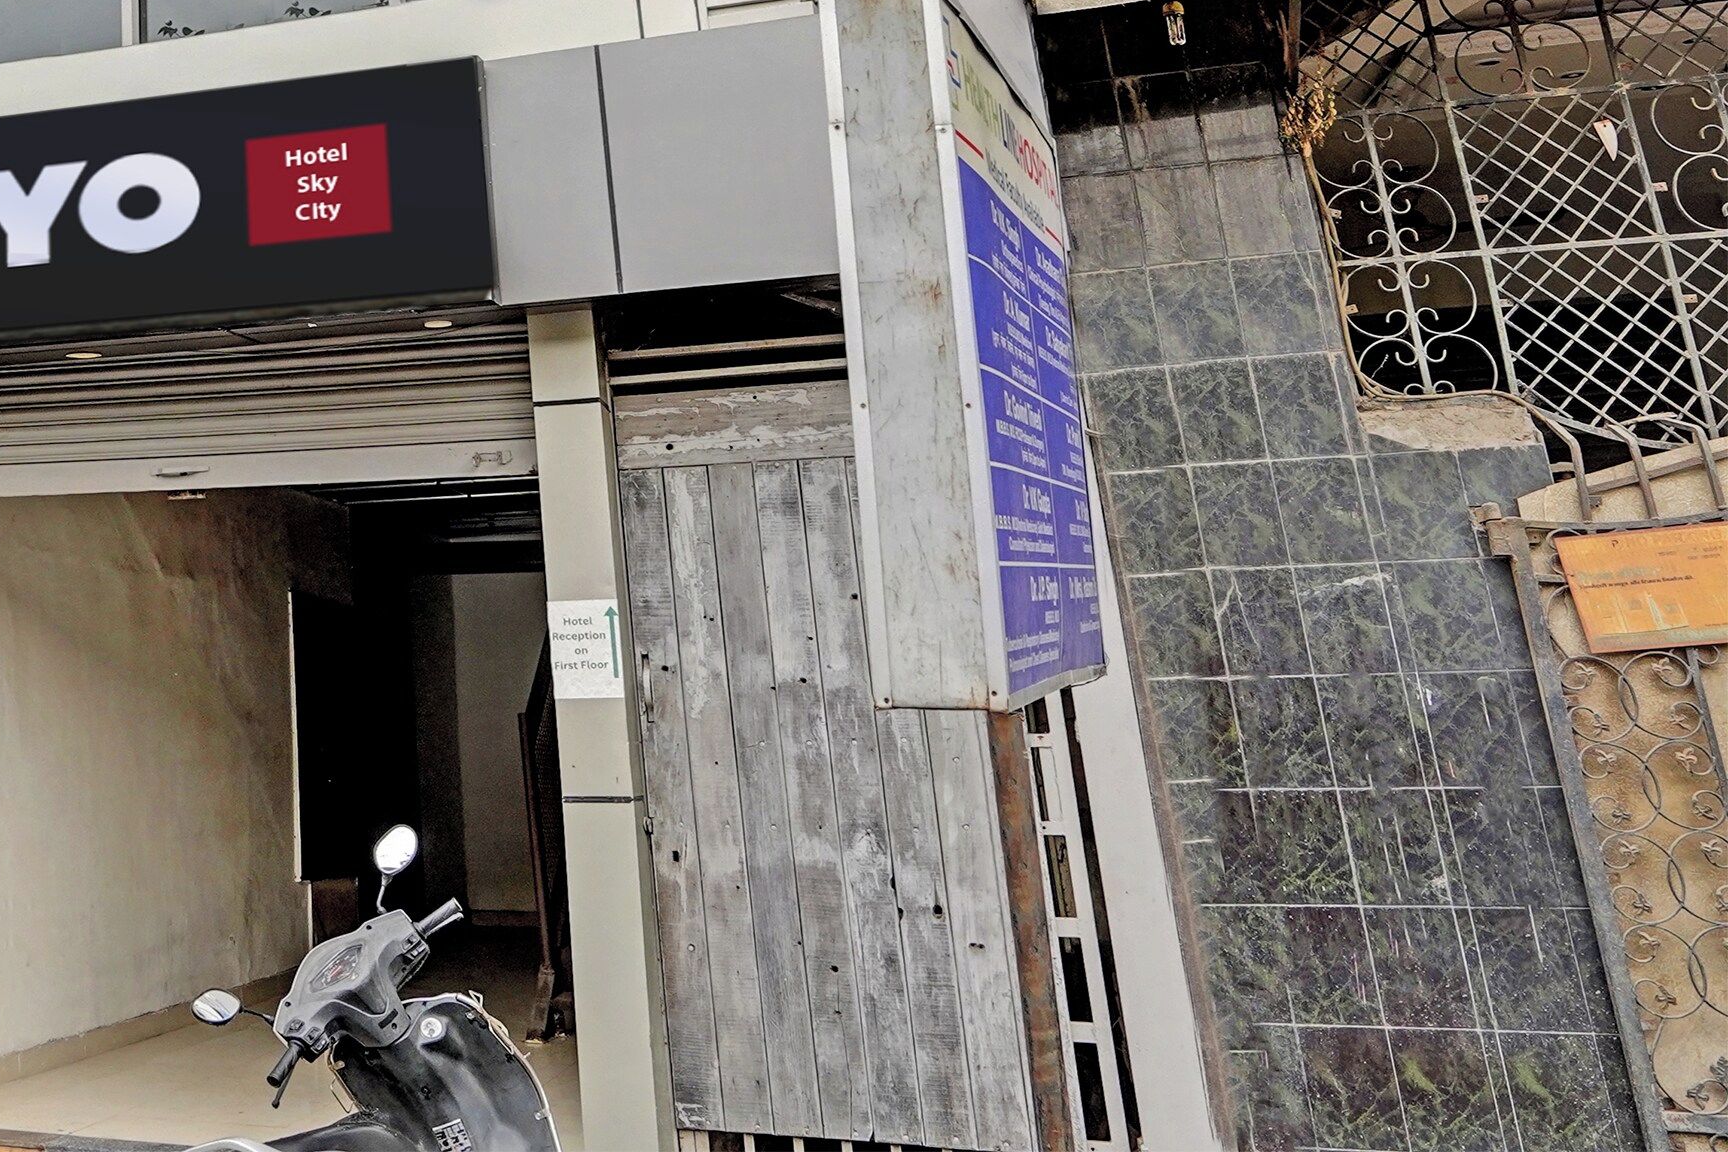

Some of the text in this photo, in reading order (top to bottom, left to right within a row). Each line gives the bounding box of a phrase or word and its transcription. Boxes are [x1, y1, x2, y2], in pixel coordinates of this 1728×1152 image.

[285, 142, 347, 167] Hotel
[297, 173, 339, 194] Sky
[295, 202, 341, 222] City
[563, 617, 593, 626] Hotel
[552, 631, 606, 642] Reception
[574, 647, 588, 655] on
[554, 660, 609, 670] First Floor
